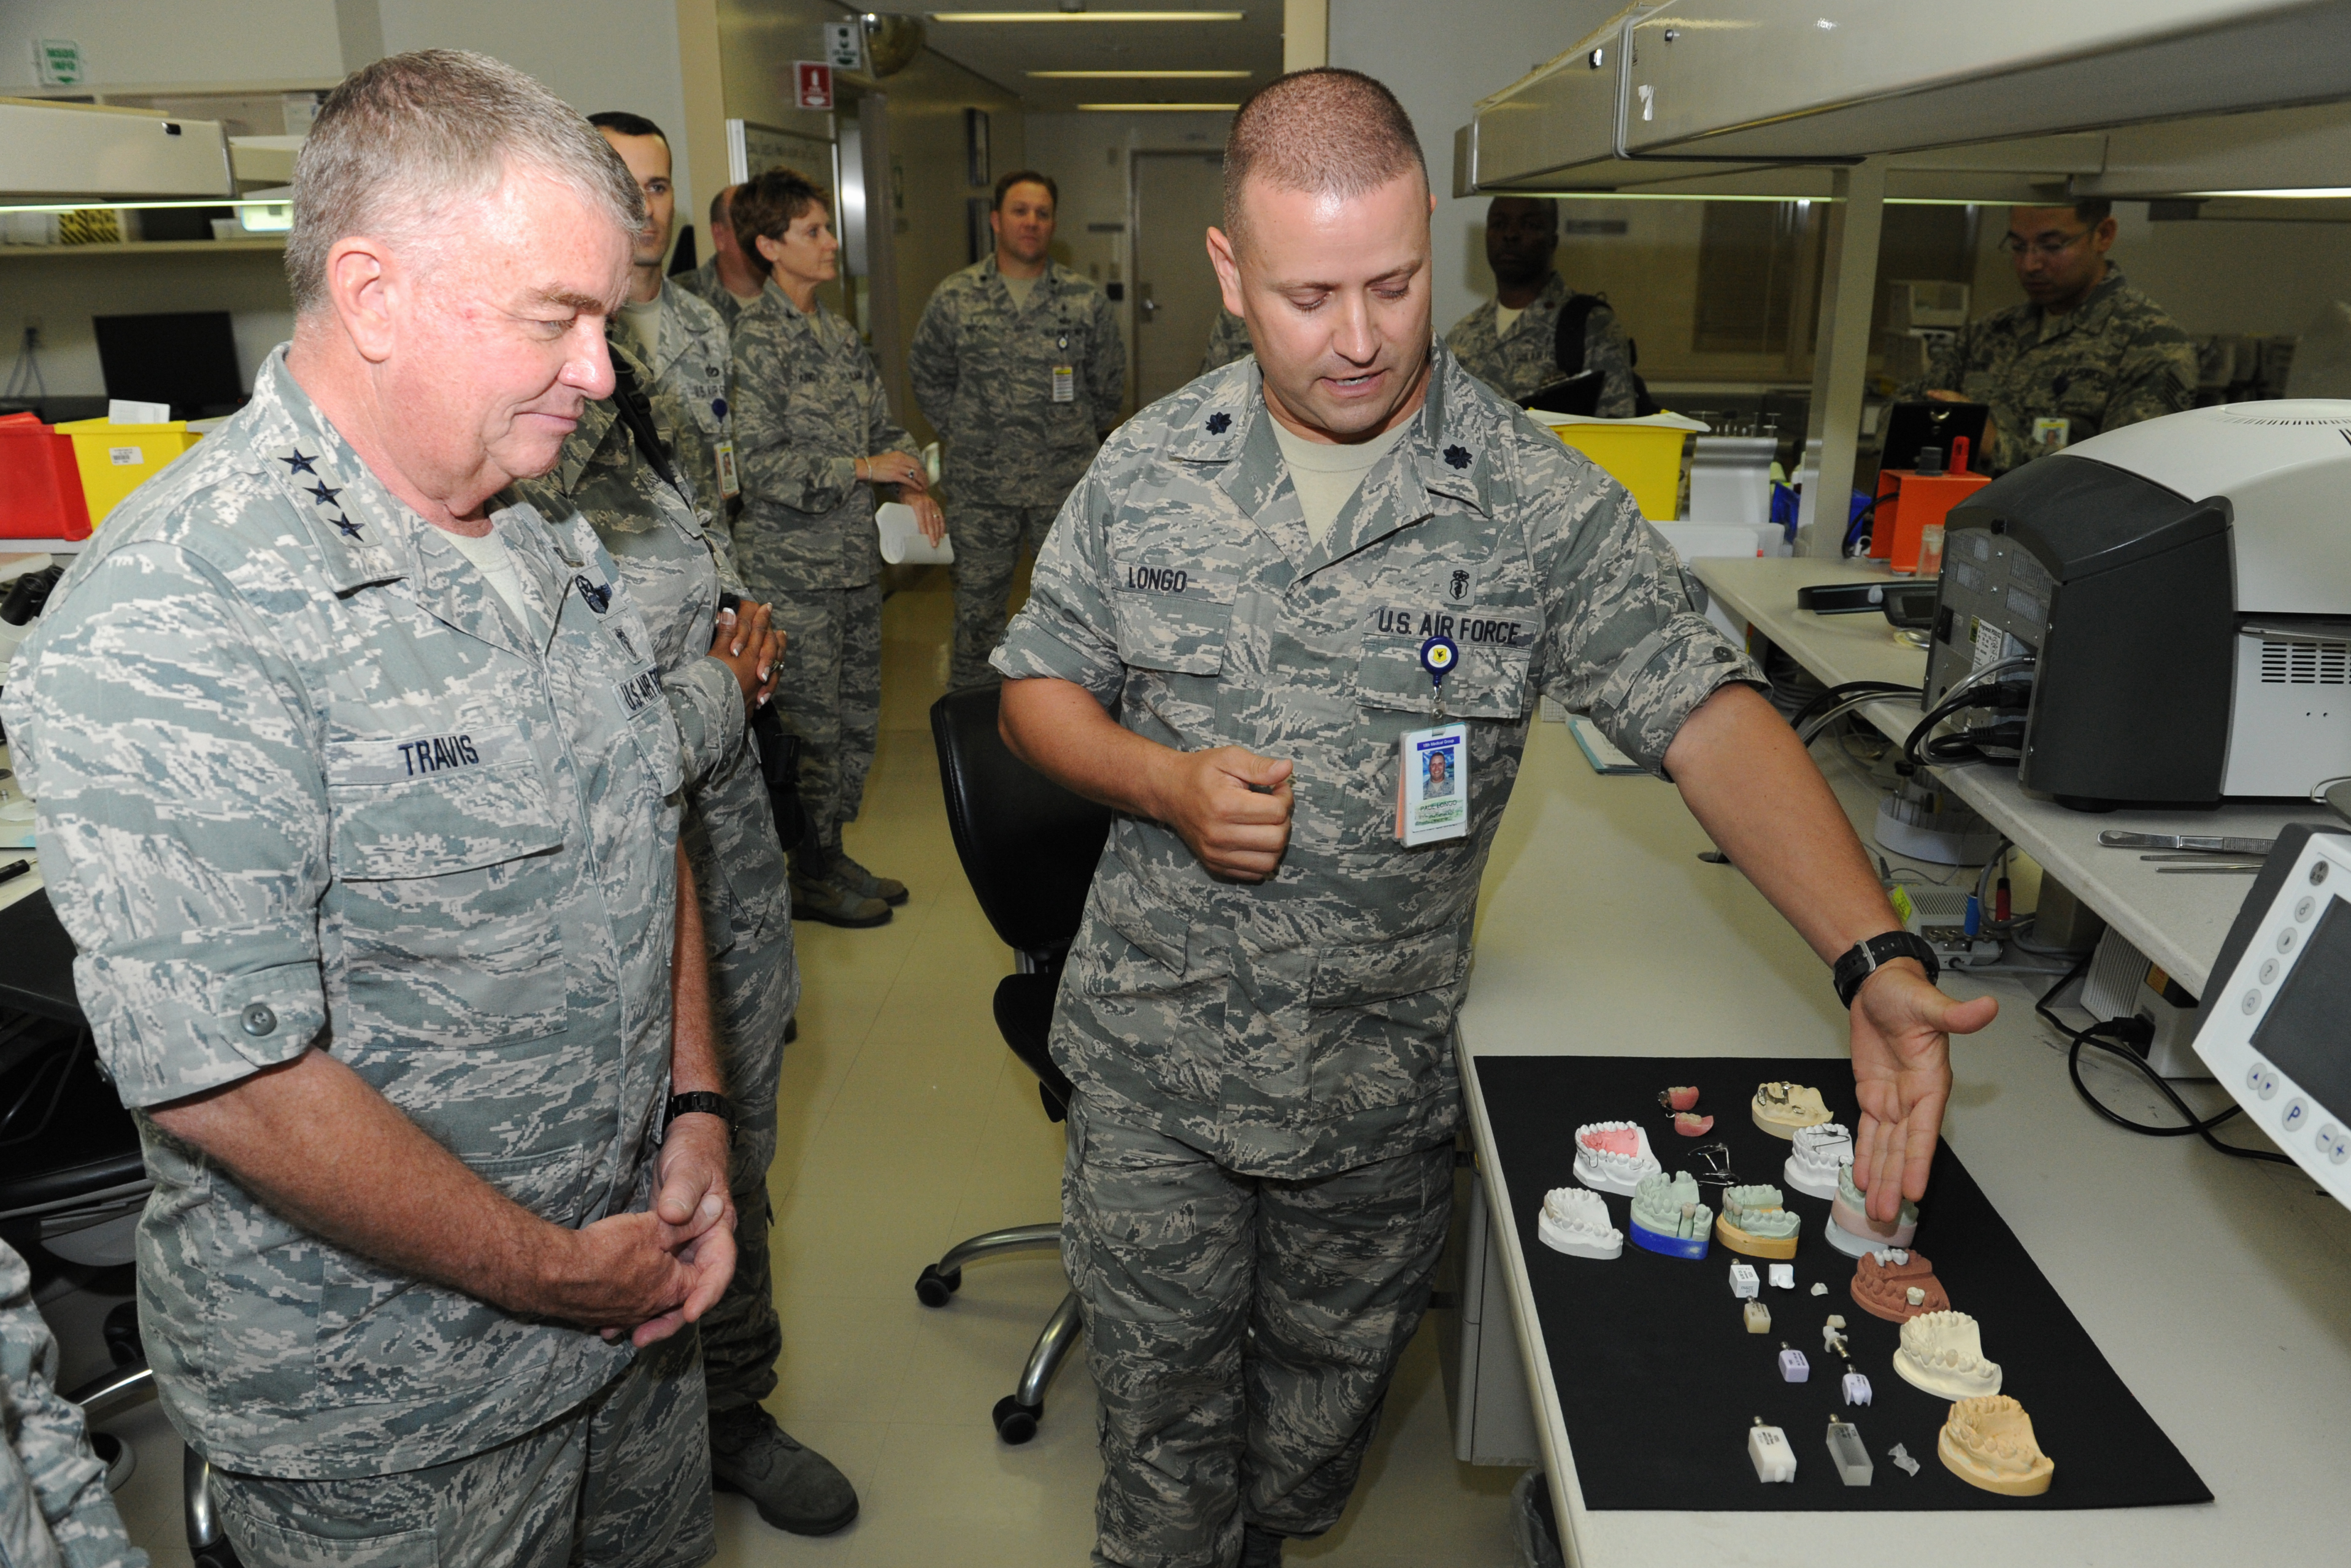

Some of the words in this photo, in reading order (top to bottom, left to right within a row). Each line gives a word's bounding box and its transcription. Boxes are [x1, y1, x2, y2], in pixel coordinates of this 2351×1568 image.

[1129, 566, 1187, 593] LONGO
[1378, 609, 1412, 635] U.S.
[1419, 612, 1455, 639] AIR
[1459, 617, 1522, 645] FORCE
[636, 674, 657, 702] AIR
[398, 735, 479, 775] TRAVIS
[1436, 799, 1457, 809] LONGO
[2287, 1105, 2300, 1122] P
